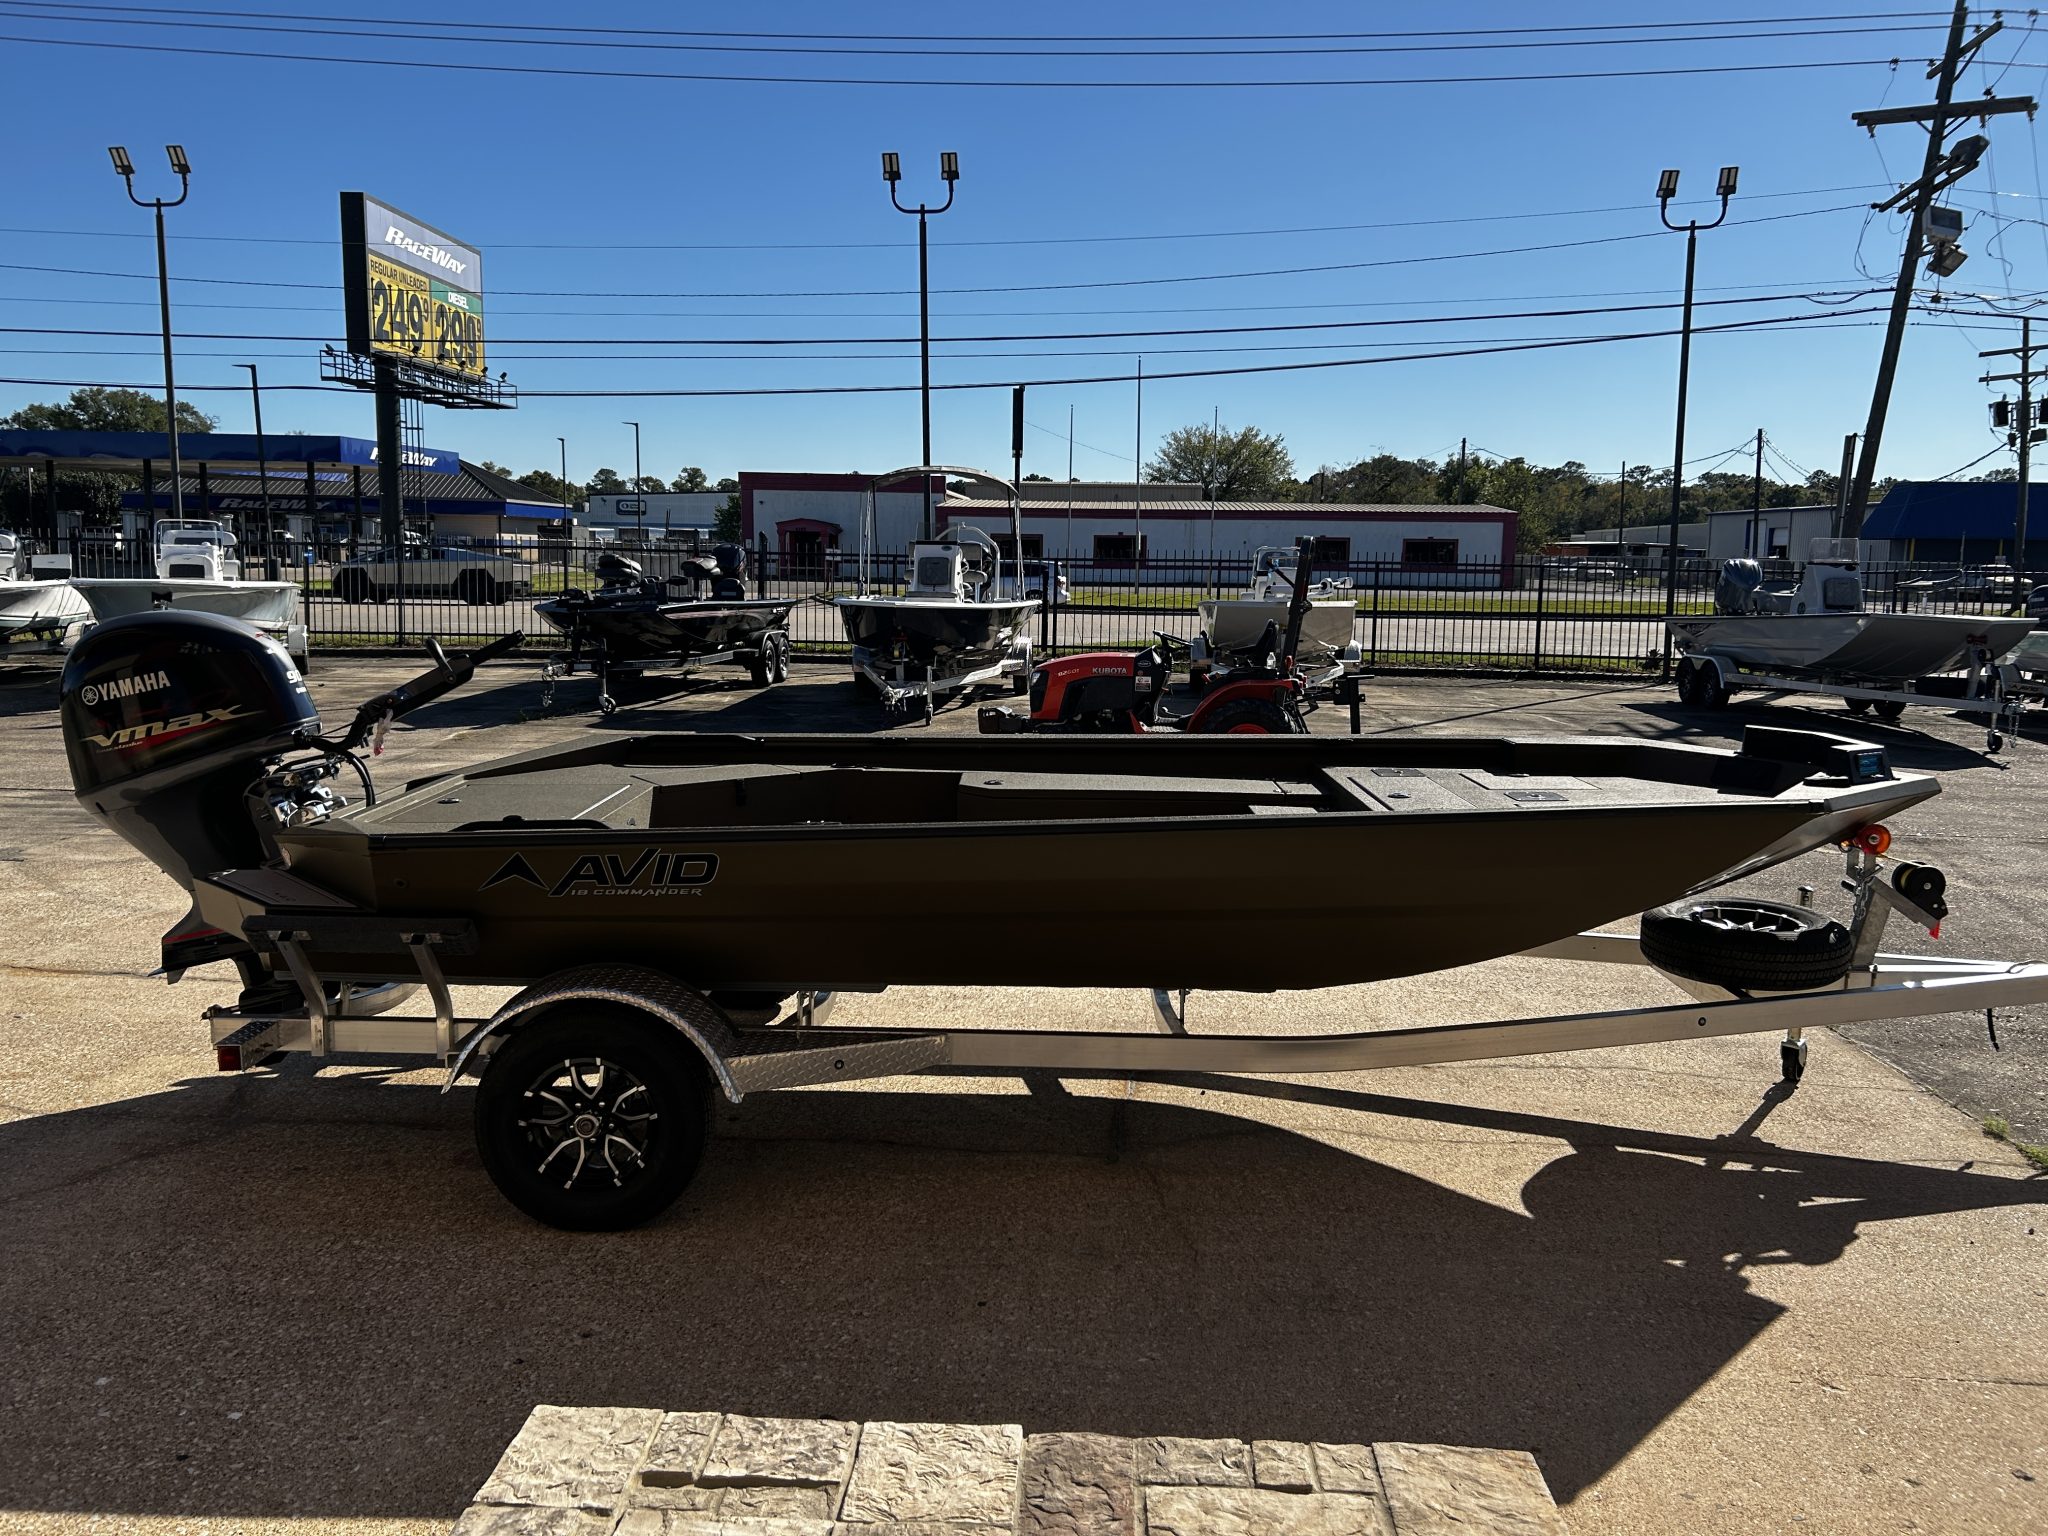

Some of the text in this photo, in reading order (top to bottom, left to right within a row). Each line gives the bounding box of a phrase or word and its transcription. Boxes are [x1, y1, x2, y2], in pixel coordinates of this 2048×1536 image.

[385, 226, 467, 274] RACEWAY
[370, 260, 428, 293] REGULAR UNLEADED
[447, 291, 469, 310] DIESEL
[286, 669, 303, 684] 90
[1092, 667, 1127, 675] KUBOTA
[98, 670, 171, 701] YAMAHA
[547, 847, 720, 897] AVID
[571, 886, 703, 897] 18 COMMANDER
